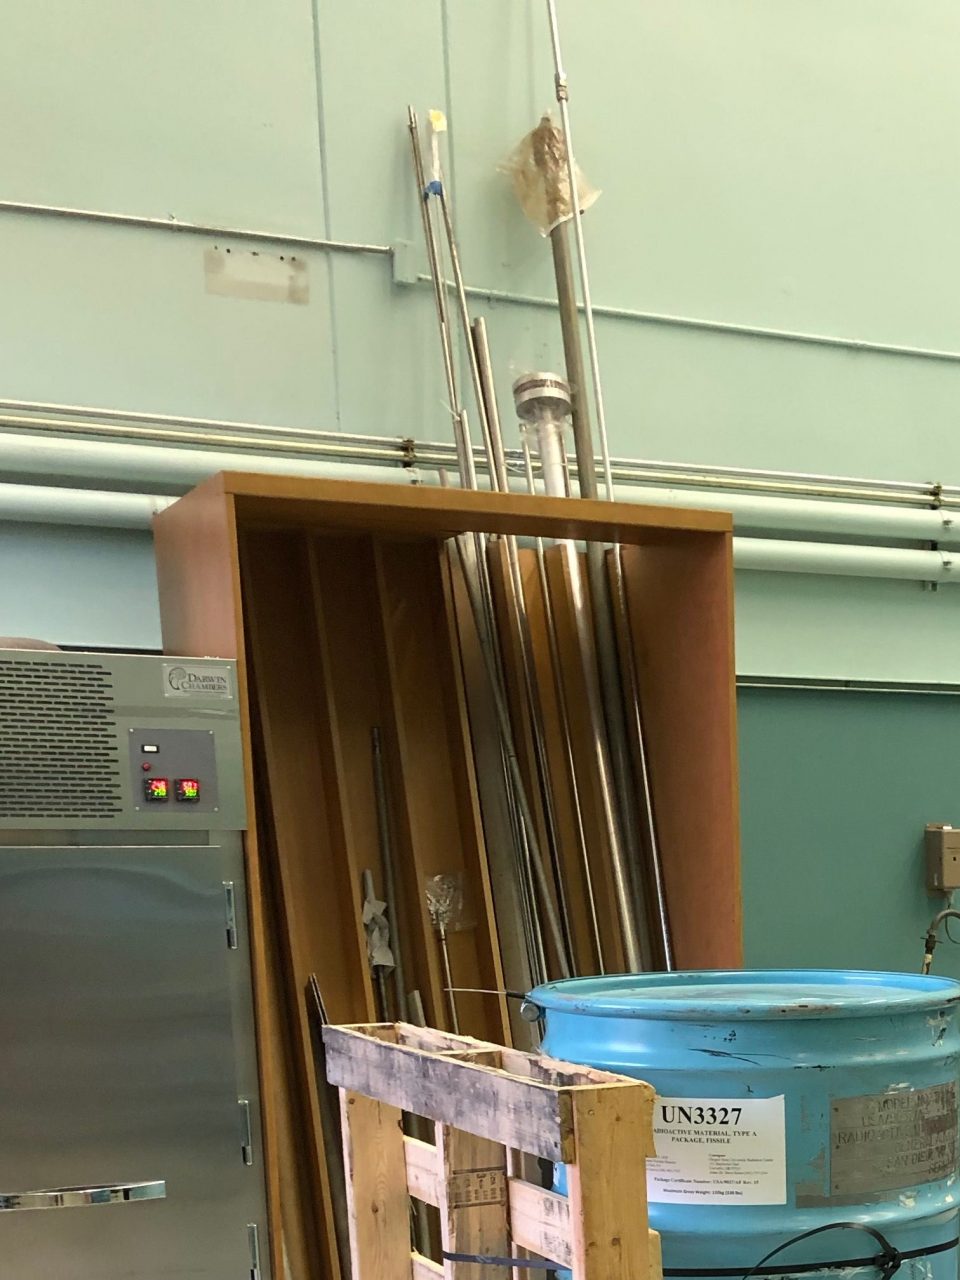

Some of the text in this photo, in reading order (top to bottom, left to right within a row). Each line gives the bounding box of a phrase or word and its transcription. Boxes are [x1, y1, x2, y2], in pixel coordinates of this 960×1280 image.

[188, 673, 227, 683] DARWIN
[661, 1105, 742, 1125] UN3327
[653, 1128, 691, 1136] ADIOACTIVE
